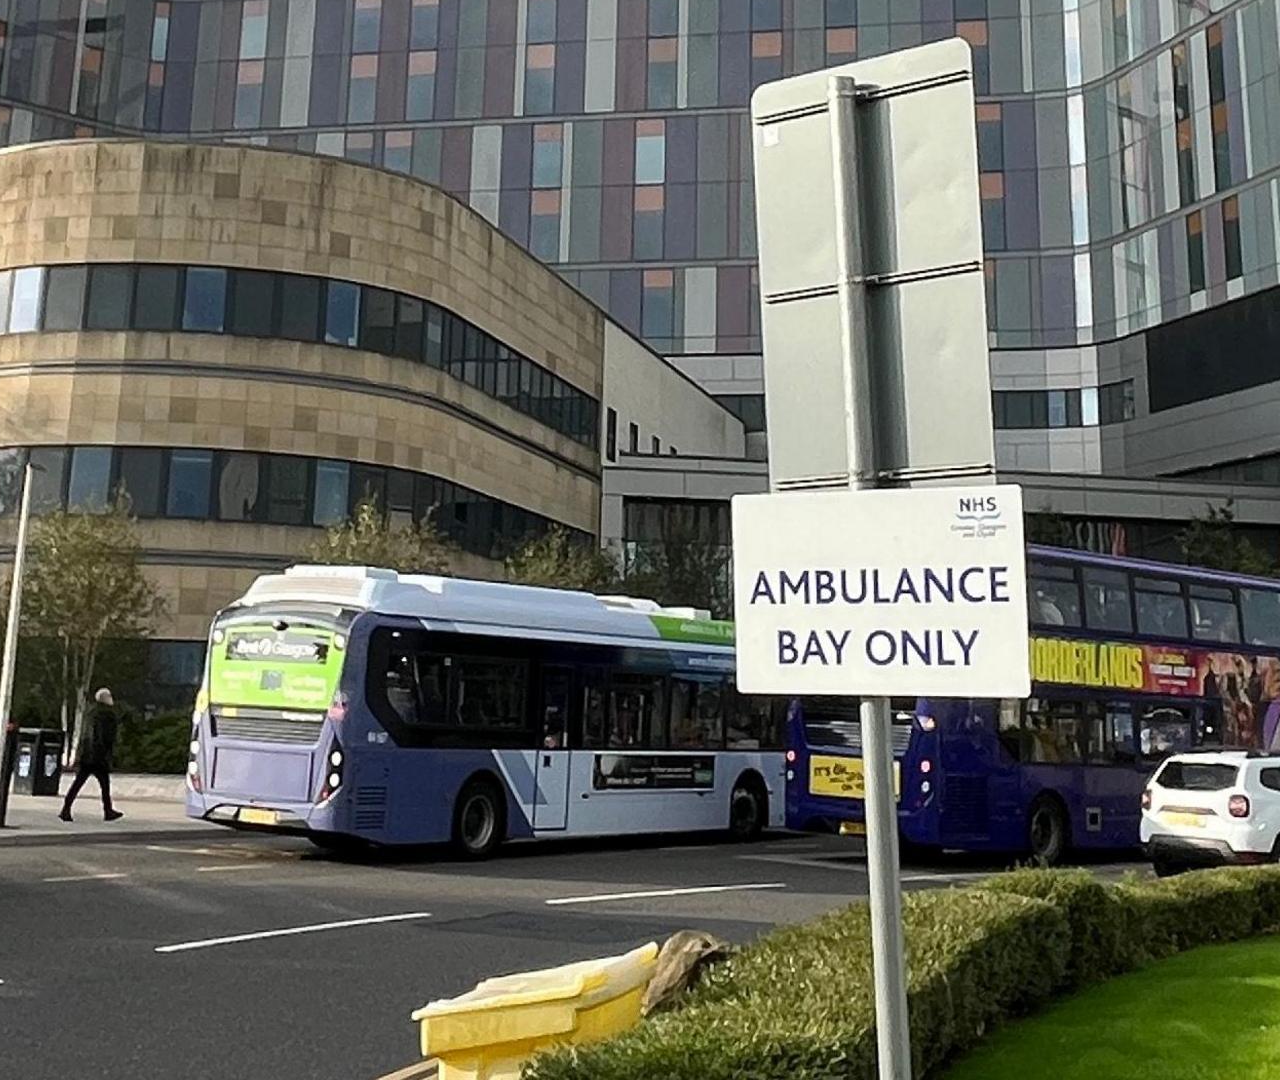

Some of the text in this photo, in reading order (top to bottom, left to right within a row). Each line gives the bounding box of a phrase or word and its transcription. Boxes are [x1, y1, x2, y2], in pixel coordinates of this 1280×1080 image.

[959, 496, 997, 512] NHS
[750, 566, 1010, 605] AMBULANCE
[777, 629, 980, 666] BAY ONLY
[1030, 637, 1143, 689] ORDERLANDS
